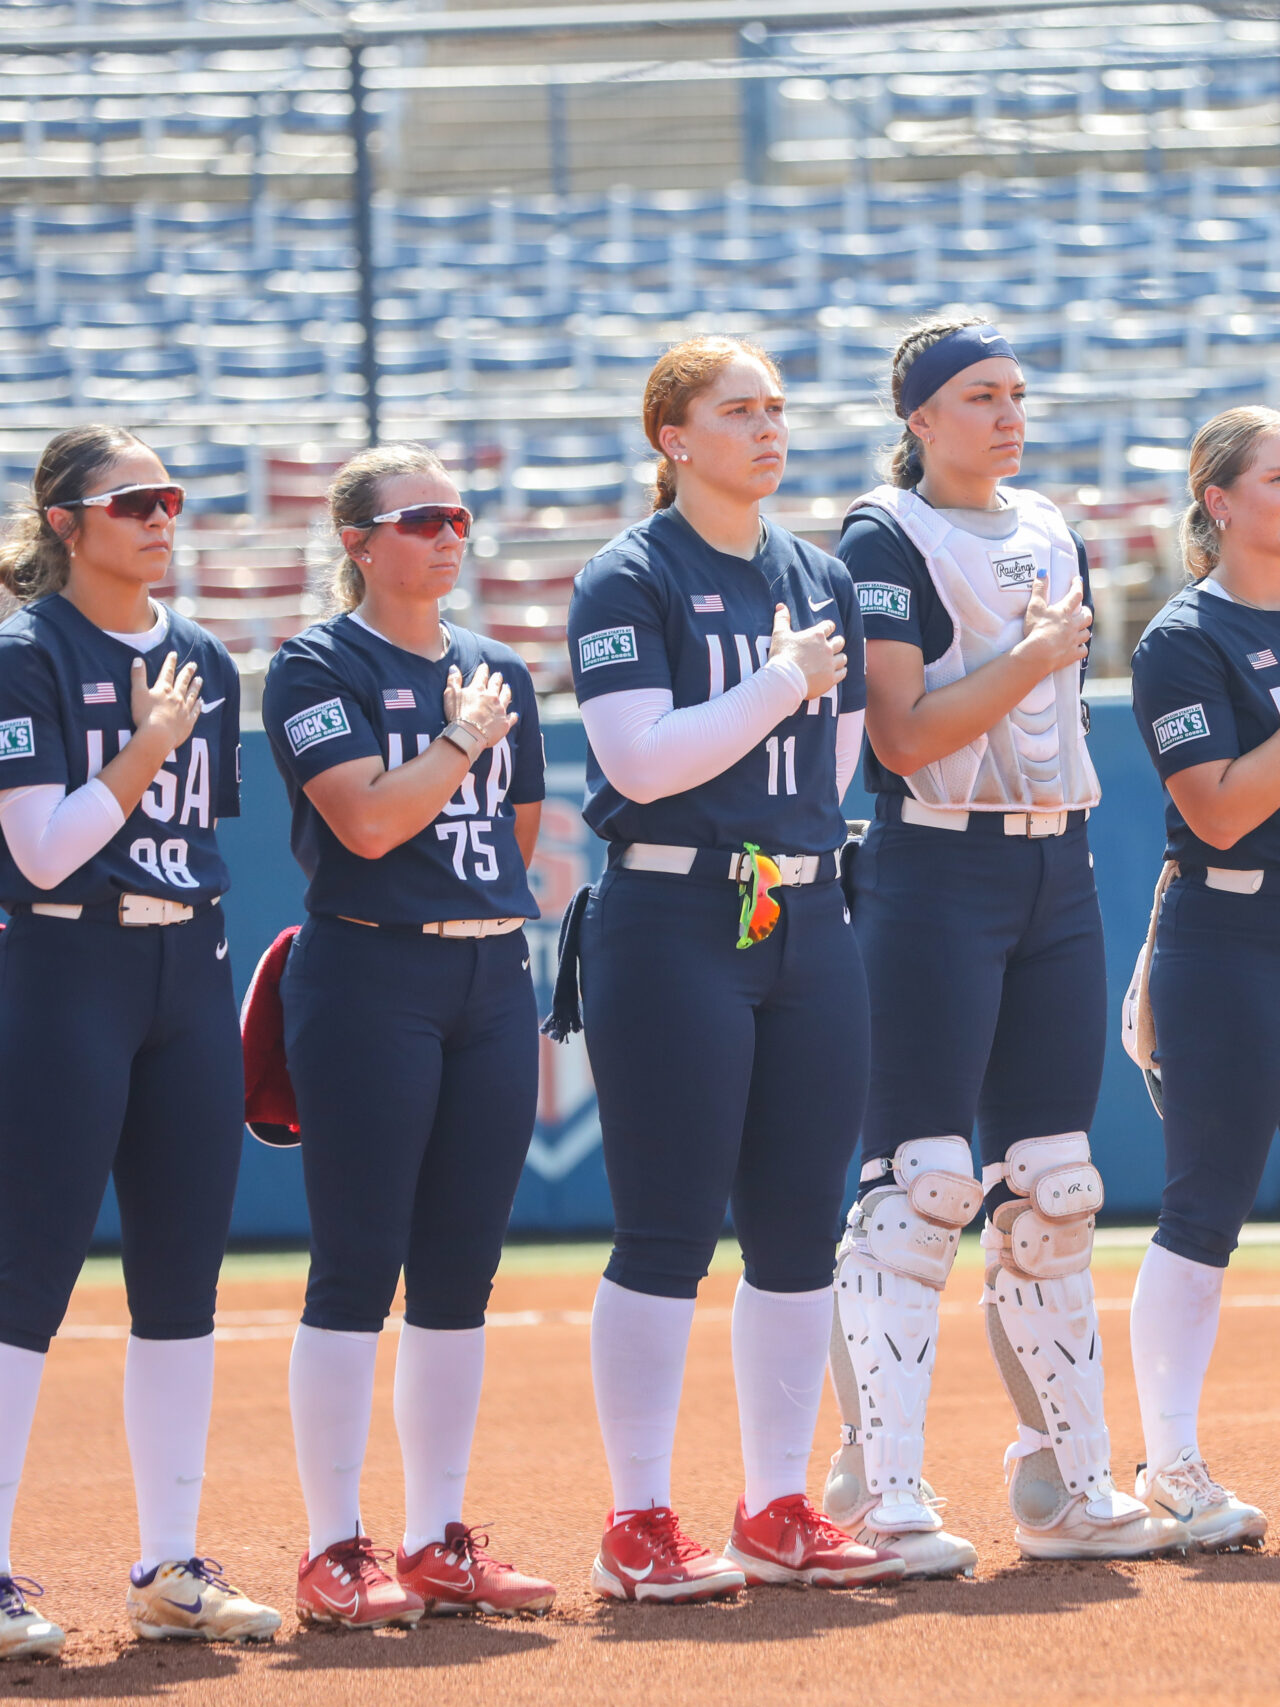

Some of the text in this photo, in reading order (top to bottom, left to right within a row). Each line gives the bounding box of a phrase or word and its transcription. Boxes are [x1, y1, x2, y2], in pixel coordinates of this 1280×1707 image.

[996, 561, 1036, 578] Rawlings
[860, 589, 907, 612] DICK'S
[887, 608, 905, 617] GOODS
[582, 635, 631, 662] DICK'S
[584, 655, 610, 667] SPORTING
[290, 708, 343, 745] DICK'S
[297, 726, 345, 748] SPORTING GOODS
[1157, 713, 1203, 743] DICK'S
[1162, 729, 1204, 748] SPORTING GOODS
[766, 736, 798, 796] 11
[435, 820, 500, 881] 75
